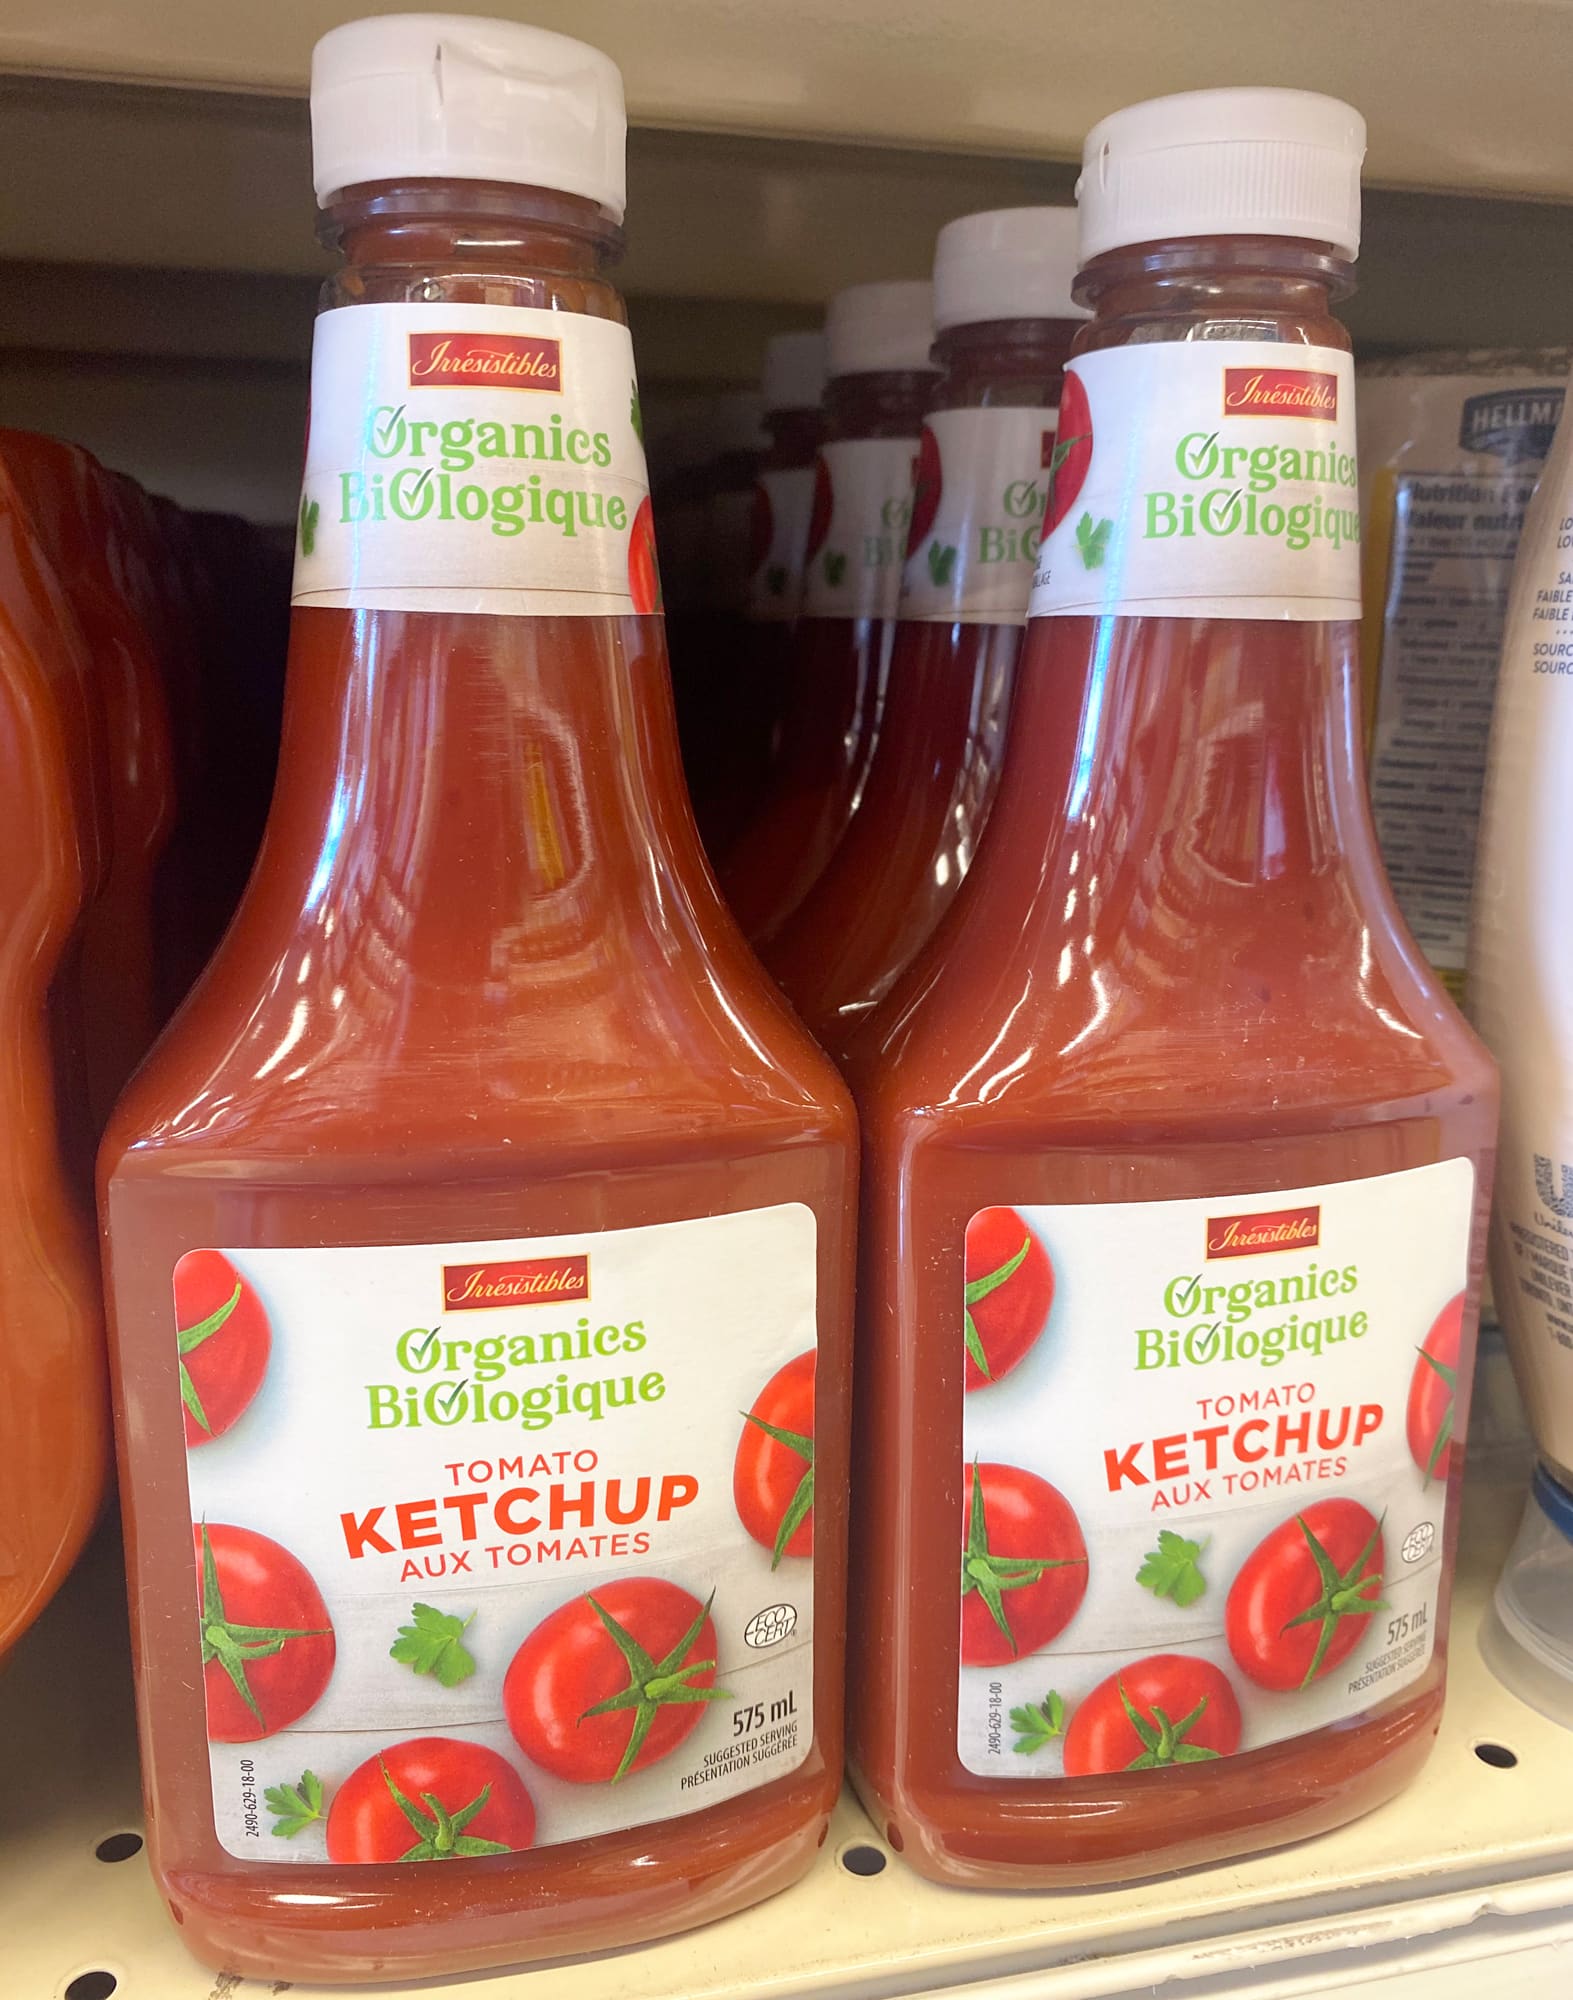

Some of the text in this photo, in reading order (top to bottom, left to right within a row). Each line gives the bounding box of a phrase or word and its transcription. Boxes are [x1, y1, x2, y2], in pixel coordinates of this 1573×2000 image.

[368, 404, 611, 471] Organics
[1175, 431, 1357, 493] Organics
[1532, 608, 1569, 621] FAIBLE
[1536, 589, 1572, 603] FAIBLE
[1533, 643, 1573, 657] SOURC
[1533, 661, 1573, 675] SOURC
[1164, 1263, 1358, 1324] Organics
[396, 1317, 647, 1382] Organics
[1197, 1382, 1316, 1420] TOMATO
[445, 1449, 598, 1486] TOMATO
[1104, 1403, 1383, 1493] KETCHUP
[1151, 1456, 1347, 1512] AUX TOMATES
[340, 1474, 699, 1560] KETCHUP
[400, 1532, 650, 1582] AUX TOMATES
[754, 1606, 786, 1632] ECO
[754, 1618, 794, 1646] CERT
[1386, 1602, 1428, 1645] 575 mL
[733, 1690, 797, 1737] 575 mL
[988, 1682, 1002, 1755] 2490-629-18-00
[680, 1733, 798, 1790] PRÉSENTATION SUGGÉRÉE
[703, 1720, 798, 1768] SUGGESTED SERVING
[240, 1760, 259, 1837] 2490-629-18-00
